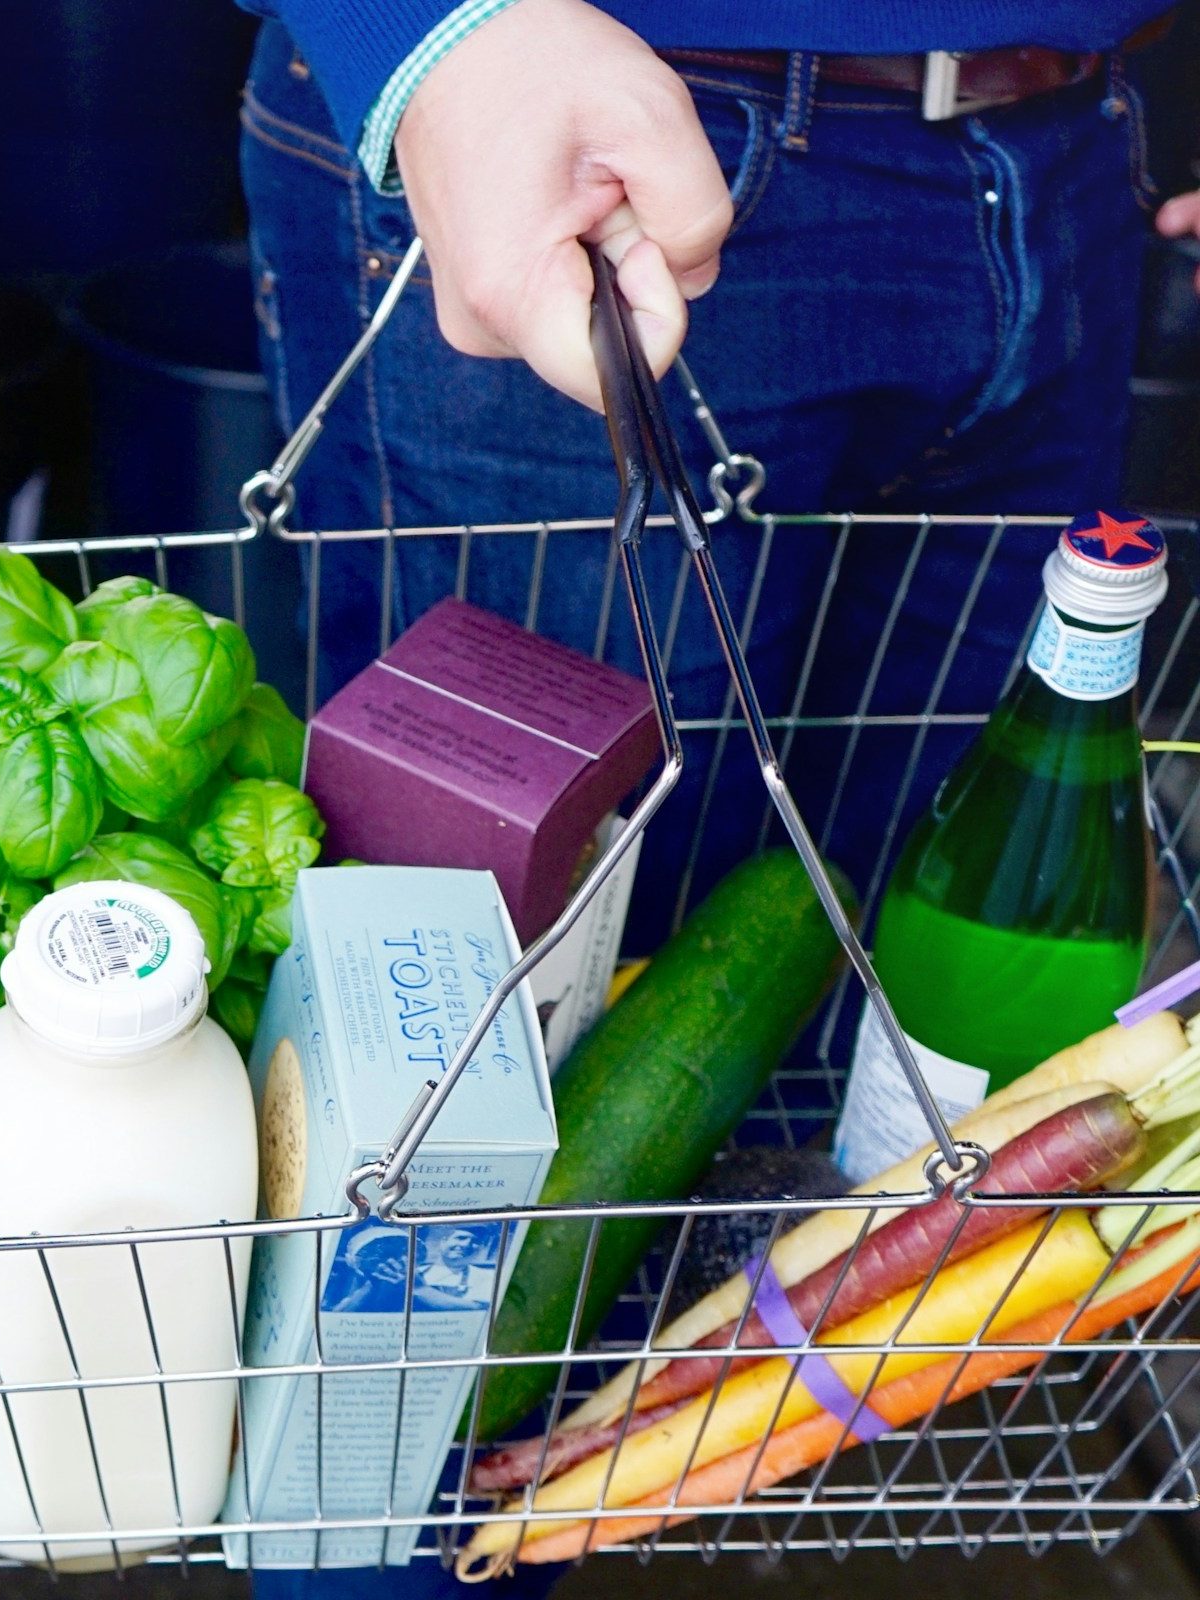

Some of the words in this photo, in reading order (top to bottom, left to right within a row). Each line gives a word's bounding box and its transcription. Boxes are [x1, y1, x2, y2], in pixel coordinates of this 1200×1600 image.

[383, 927, 452, 1072] TOAST
[350, 965, 361, 990] WITH
[362, 1027, 376, 1062] GRATED
[371, 1011, 386, 1044] TOASTS
[405, 1163, 456, 1174] MEET
[461, 1165, 493, 1174] THE
[410, 1180, 506, 1189] EESEMAKER
[420, 1197, 482, 1207] Schneider
